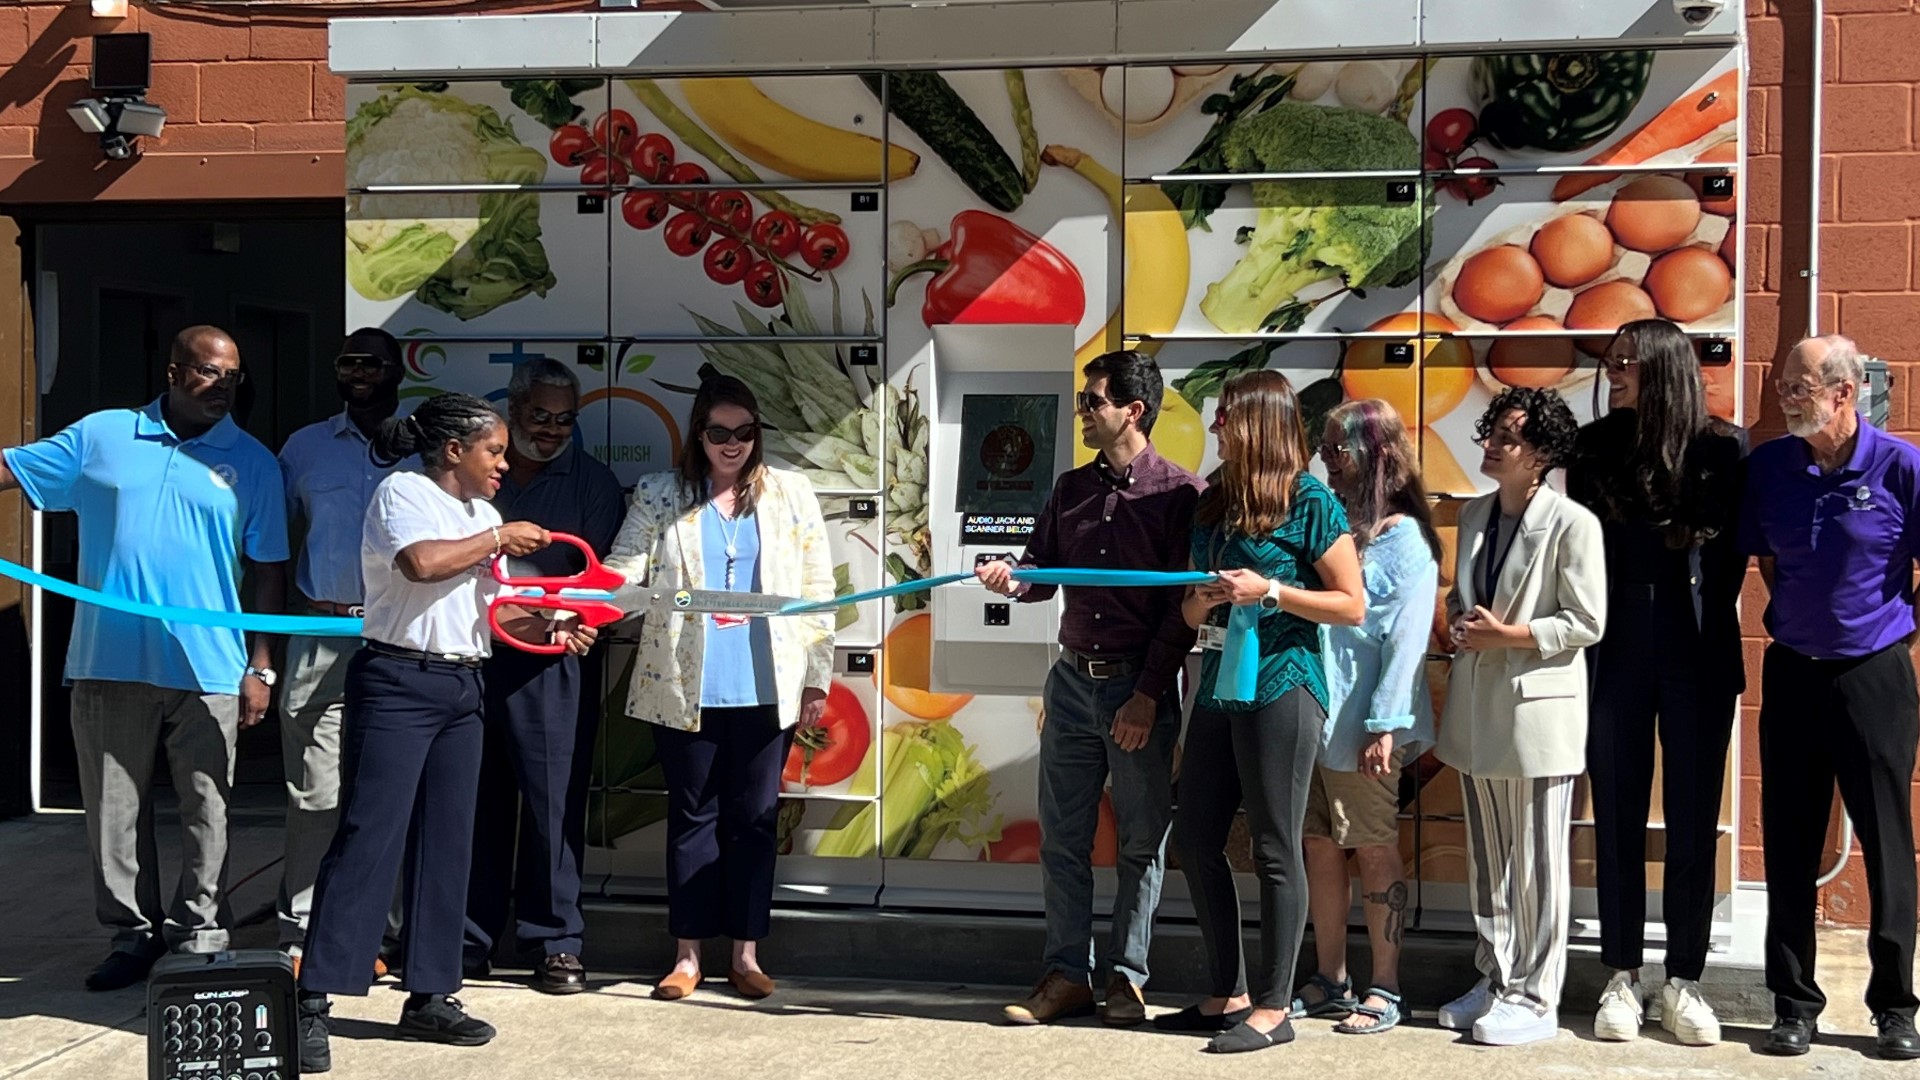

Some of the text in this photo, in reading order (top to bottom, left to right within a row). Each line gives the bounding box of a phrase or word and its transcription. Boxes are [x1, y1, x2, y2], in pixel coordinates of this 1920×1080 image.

[585, 198, 596, 206] A1
[859, 195, 870, 204] B1
[585, 348, 596, 356] A2
[858, 349, 870, 358] B2
[594, 445, 651, 463] NOURISH
[857, 502, 869, 511] B3
[967, 516, 1036, 525] AUDIO JACK AND
[965, 525, 1005, 533] SCANNER
